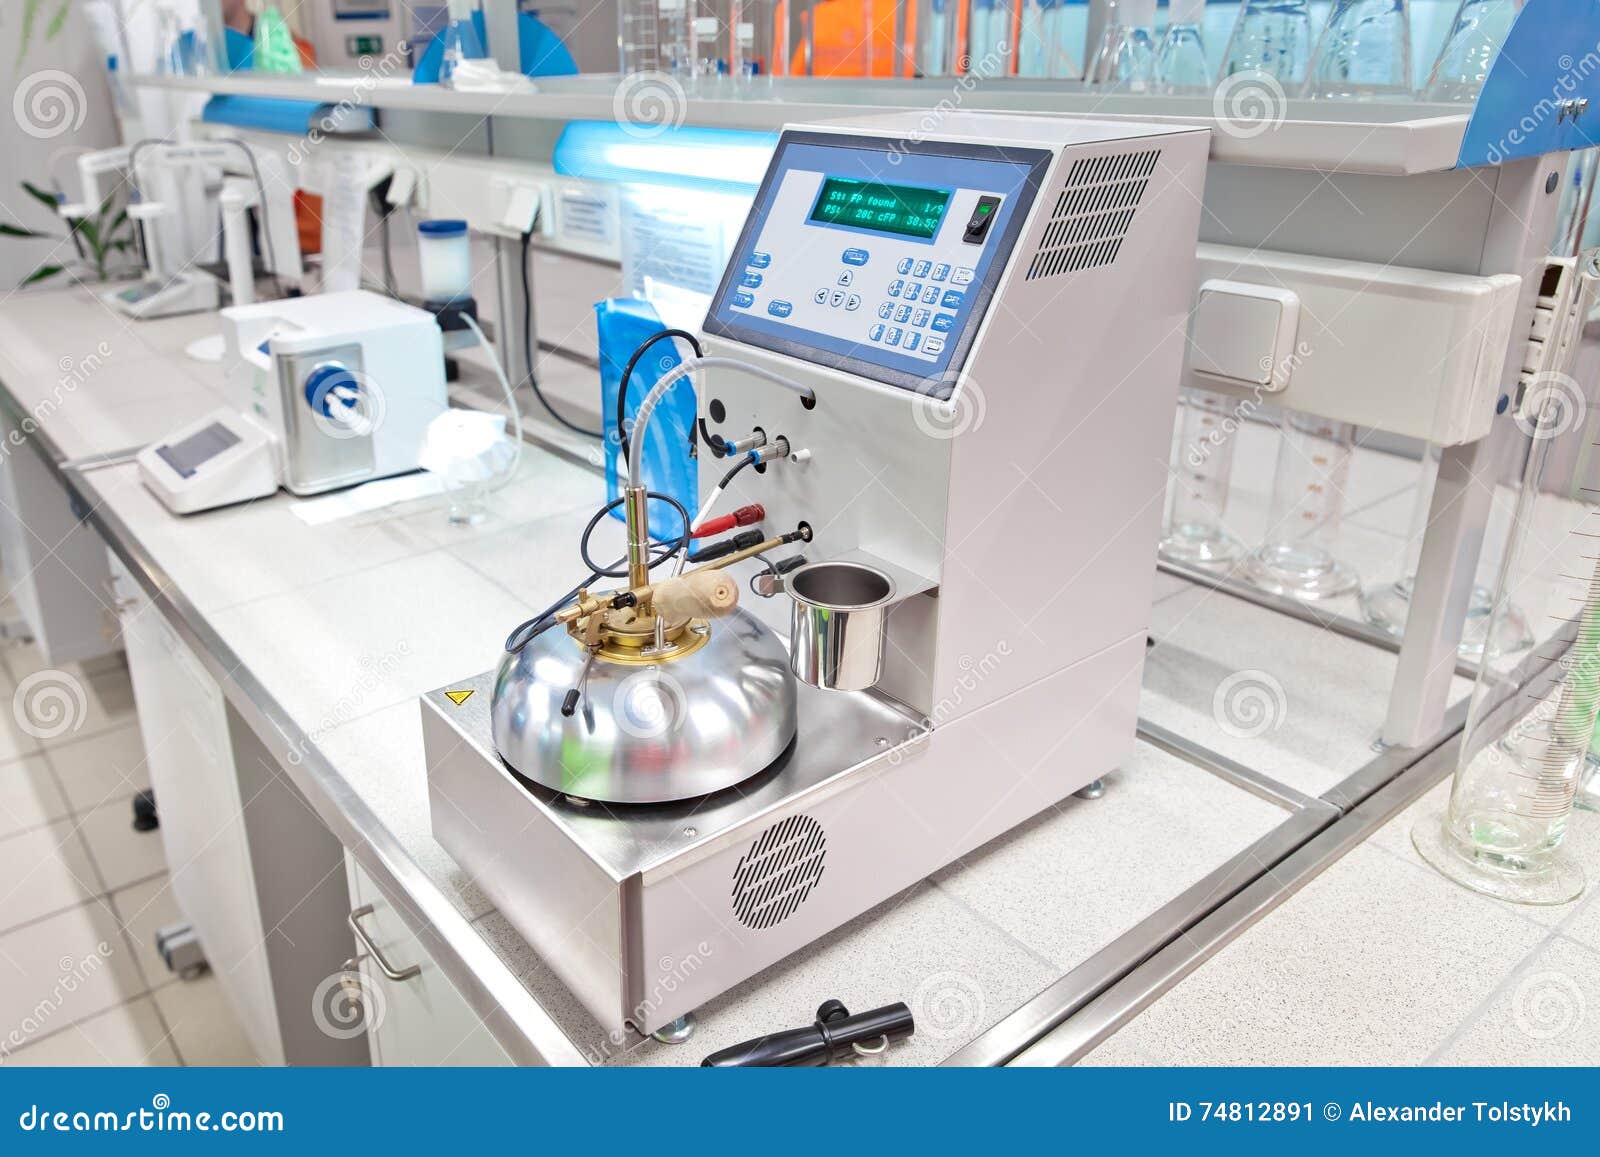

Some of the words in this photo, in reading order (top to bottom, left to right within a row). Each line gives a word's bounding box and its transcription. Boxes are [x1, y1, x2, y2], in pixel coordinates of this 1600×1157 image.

[850, 194, 863, 204] FP
[867, 196, 897, 208] found
[923, 203, 944, 214] 1/9
[877, 212, 896, 222] cFP
